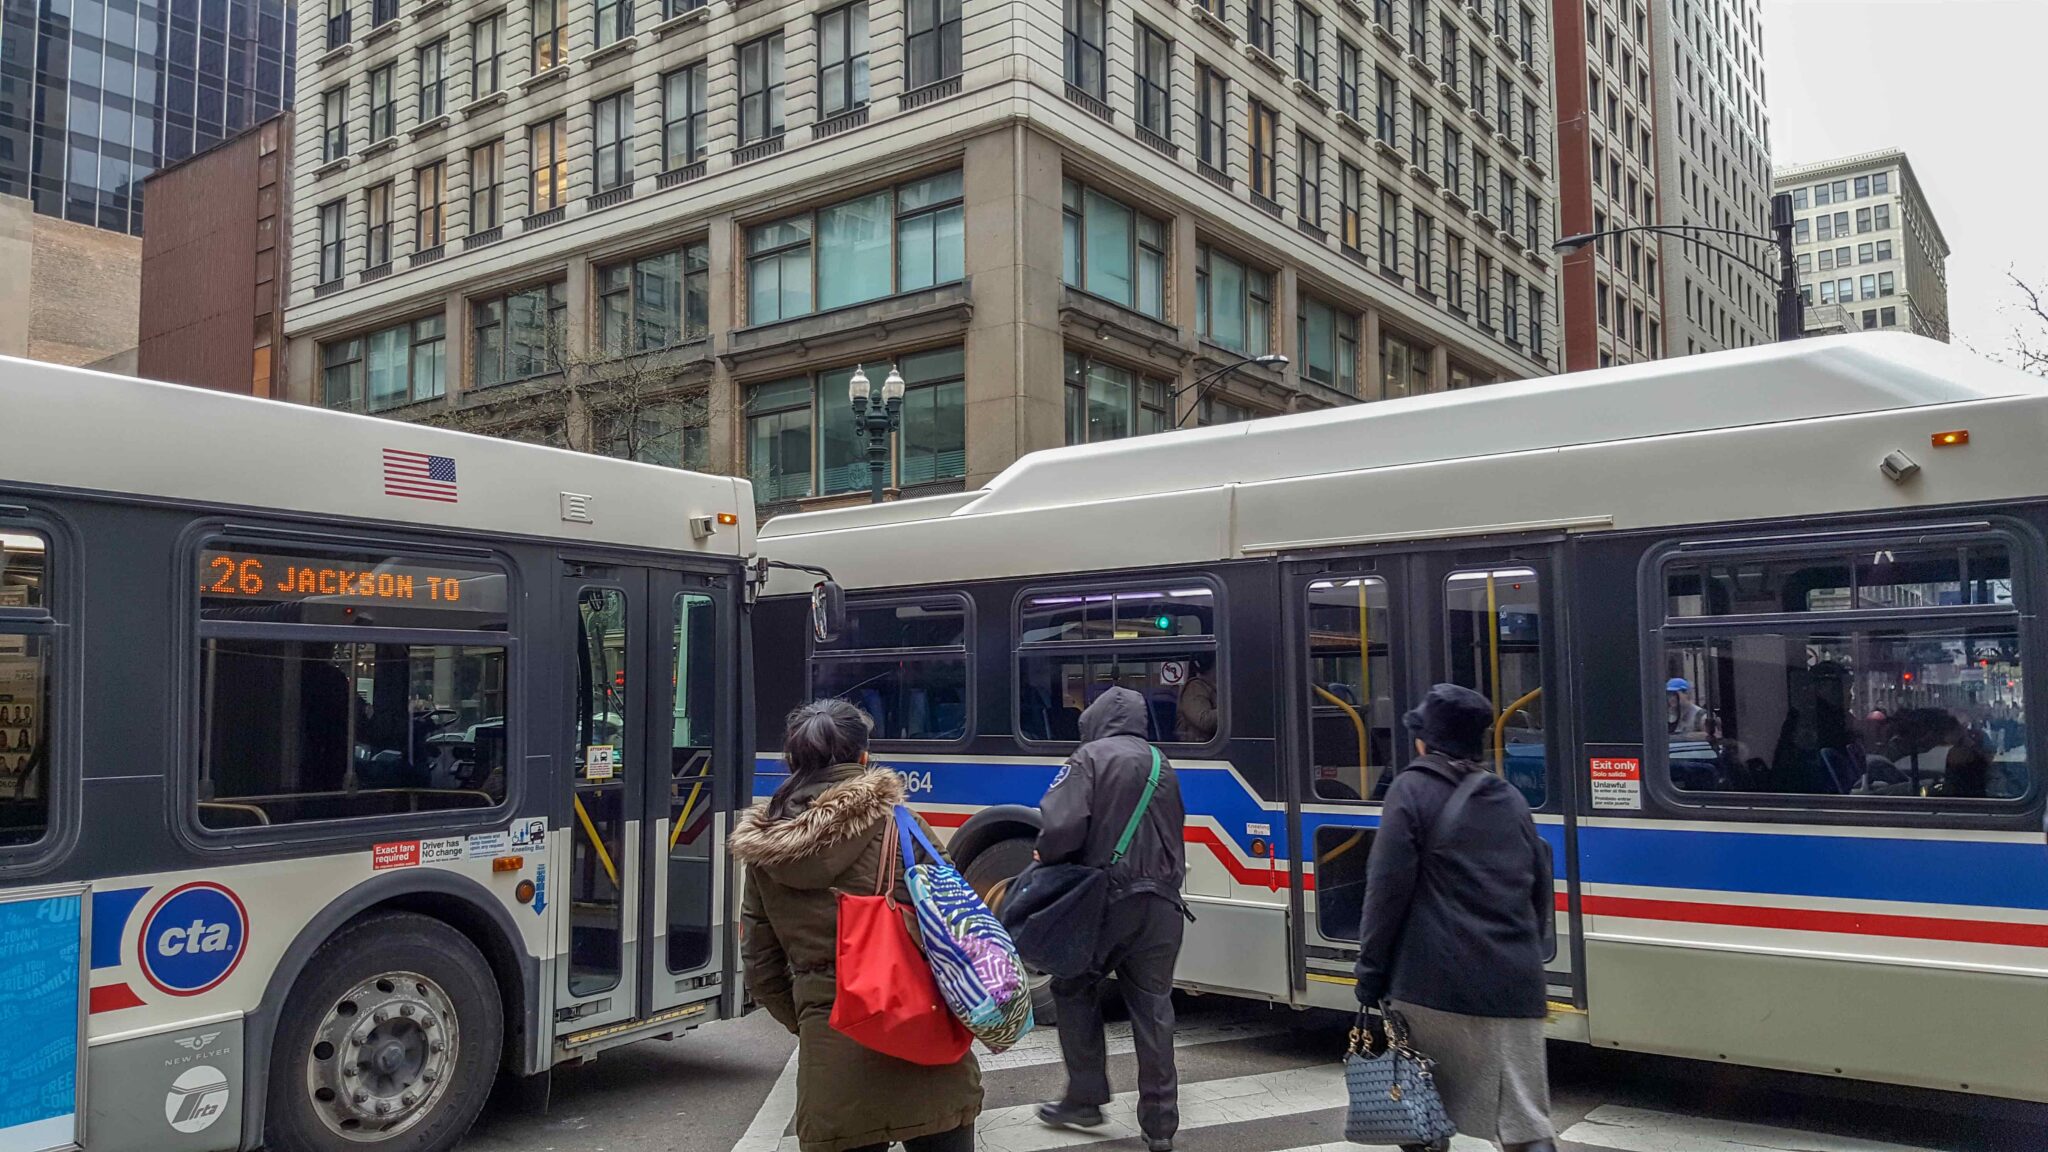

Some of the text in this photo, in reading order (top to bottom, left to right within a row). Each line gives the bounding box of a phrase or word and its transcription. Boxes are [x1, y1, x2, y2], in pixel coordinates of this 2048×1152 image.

[200, 556, 459, 601] 26 JACKSON TO
[1592, 760, 1636, 772] Exit only
[376, 843, 416, 855] Exact fare
[422, 839, 460, 850] Driver has
[511, 845, 534, 853] Kneeling
[375, 852, 410, 864] required
[421, 850, 435, 858] NO
[436, 848, 463, 857] change
[158, 919, 230, 957] cta
[164, 1047, 232, 1067] NEW FLYER
[193, 1103, 219, 1120] rta
